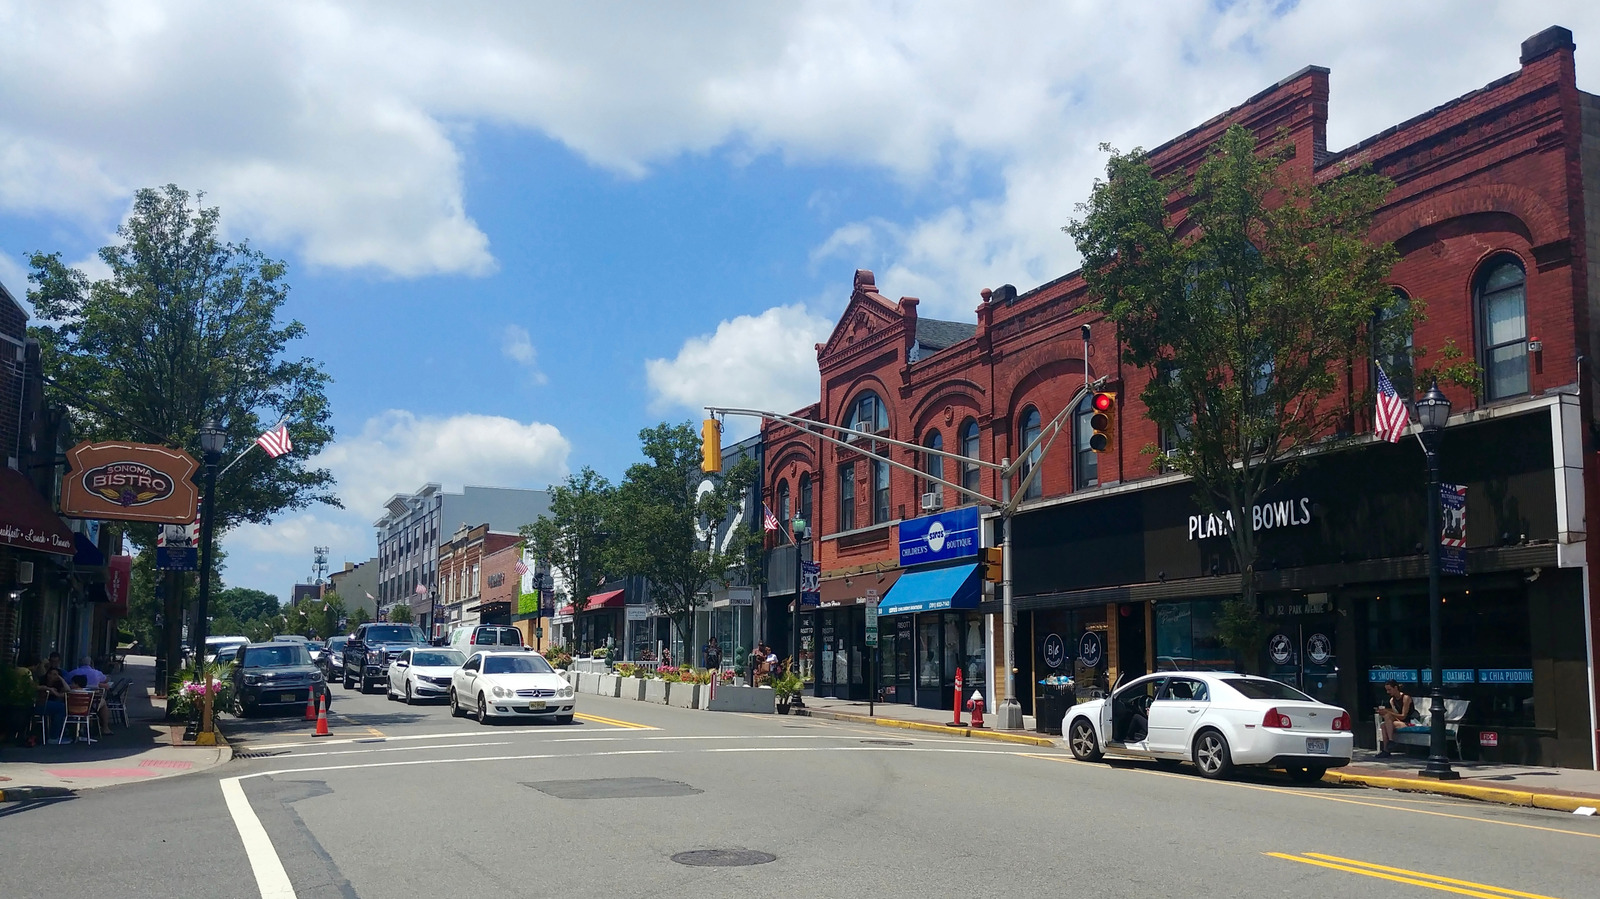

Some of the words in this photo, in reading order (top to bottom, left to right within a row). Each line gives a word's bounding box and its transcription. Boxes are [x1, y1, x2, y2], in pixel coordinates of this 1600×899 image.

[107, 465, 152, 477] SONOMA
[93, 474, 167, 491] BISTRO
[1252, 497, 1310, 531] BOWLS
[25, 529, 46, 543] Lunch
[902, 545, 928, 557] CHILDREN'S
[946, 537, 973, 550] BOUTIQUE
[1378, 671, 1409, 680] SMOOTHIES
[1446, 671, 1473, 681] OATMEAL
[1489, 671, 1505, 681] CHIA
[1505, 671, 1533, 681] PUDDING
